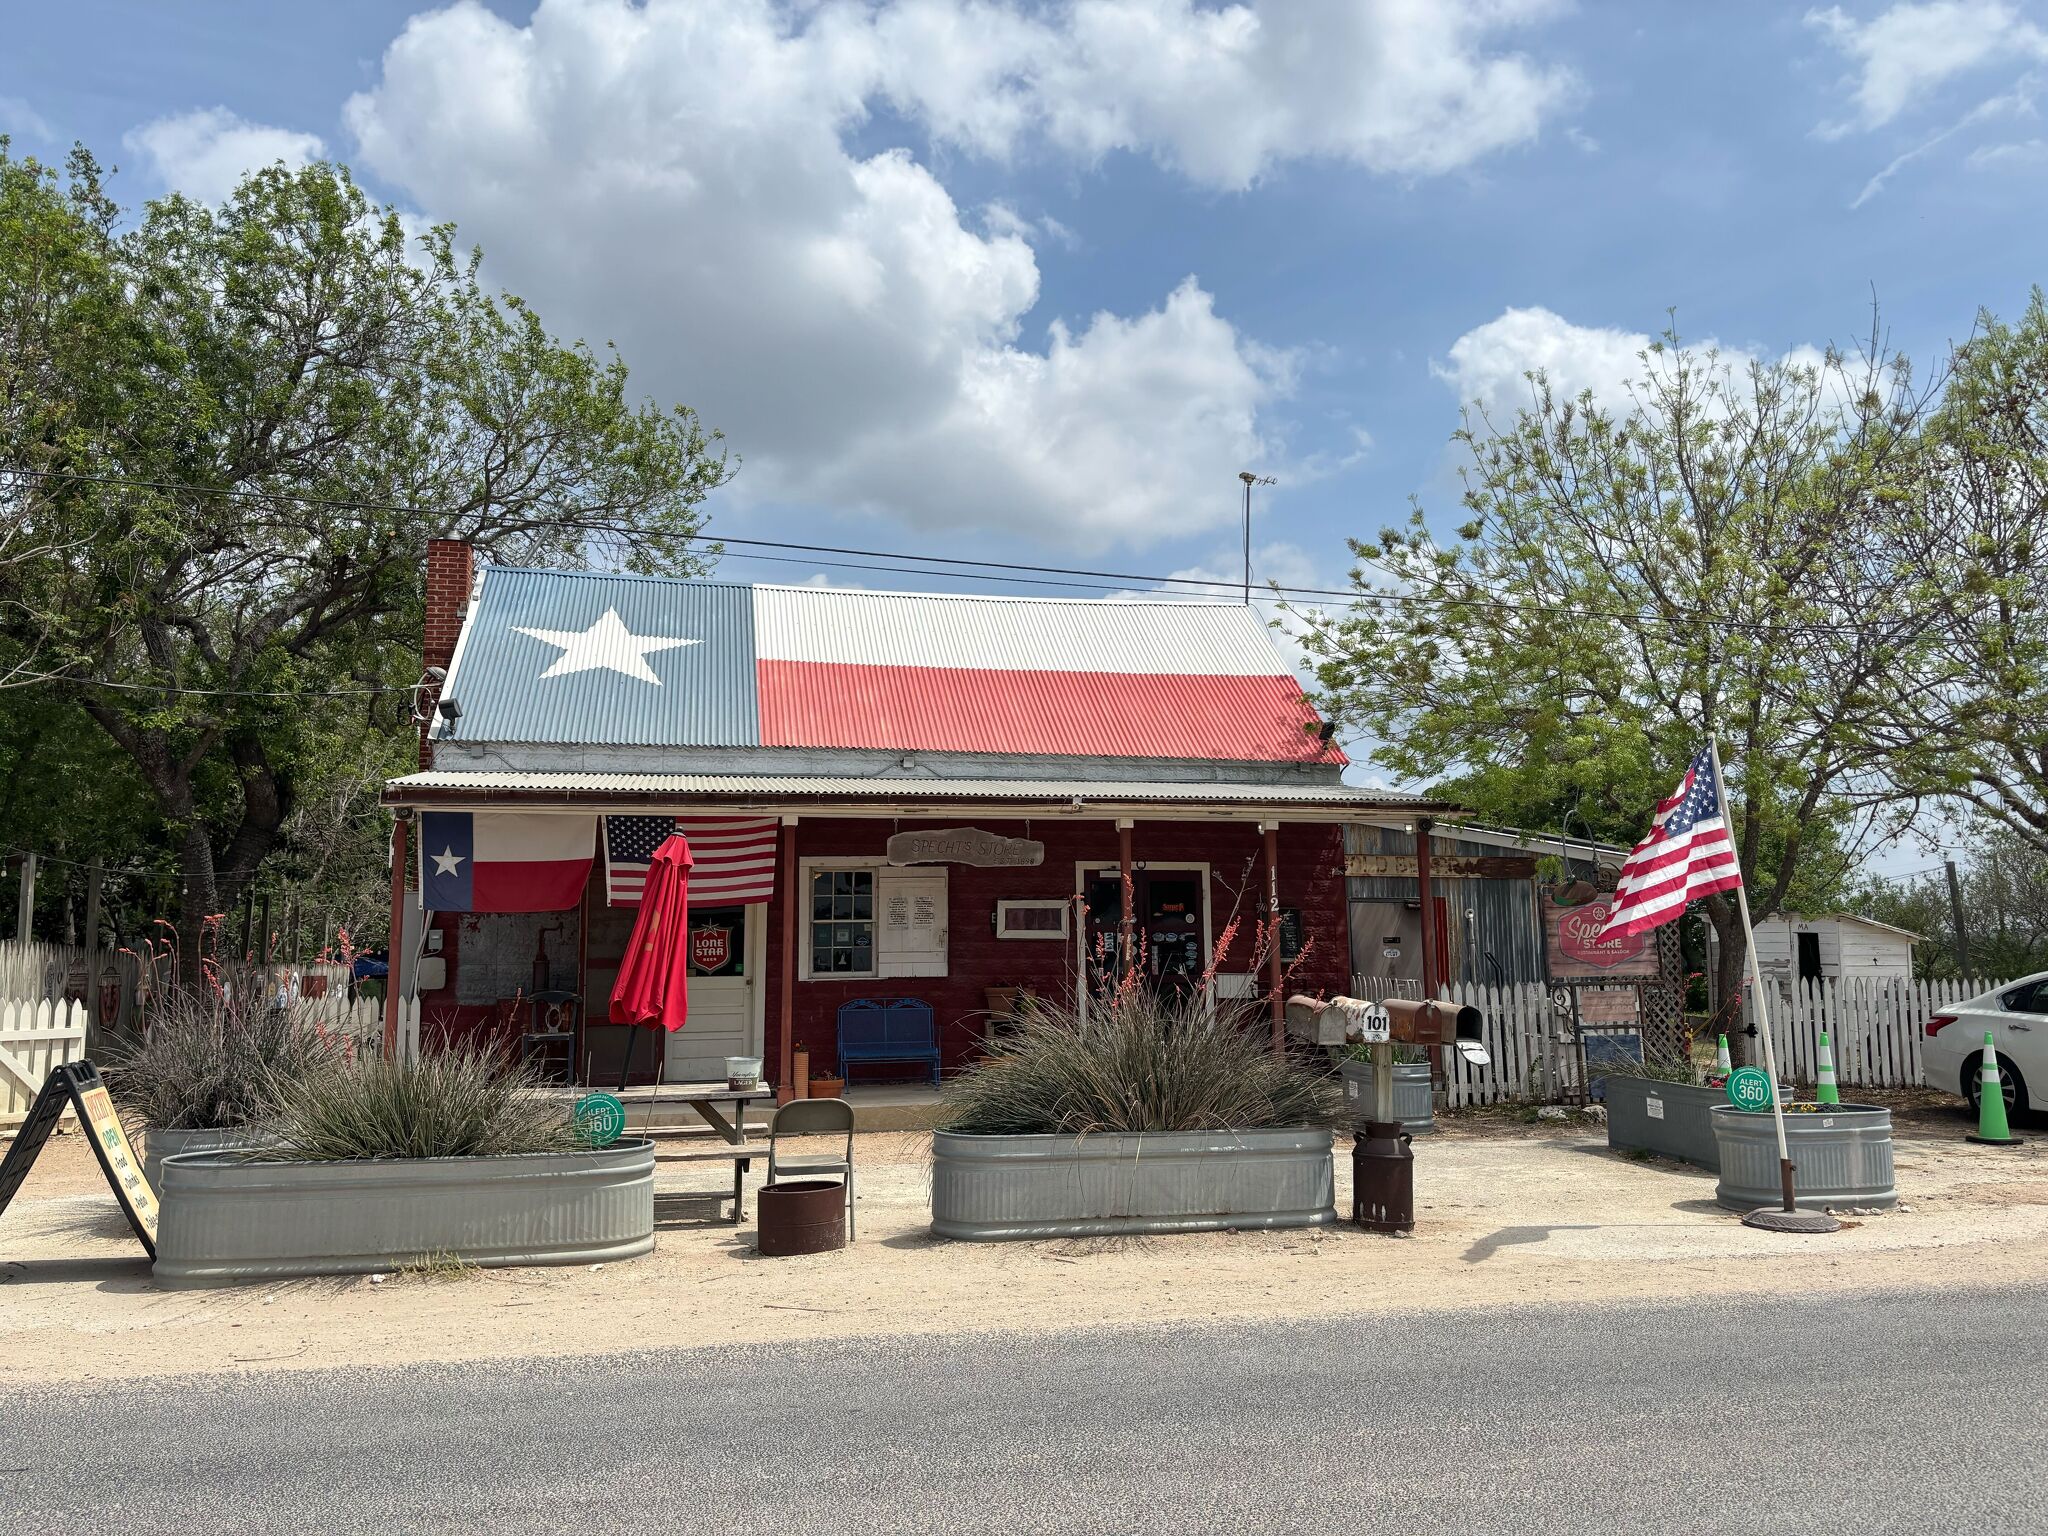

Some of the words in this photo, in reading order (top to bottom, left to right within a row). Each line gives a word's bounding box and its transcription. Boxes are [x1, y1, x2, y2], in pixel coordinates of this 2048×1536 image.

[911, 838, 972, 853] SPECHT'S
[977, 841, 1023, 857] STORE
[696, 939, 724, 948] LONE
[696, 947, 724, 957] STAR
[1367, 1015, 1387, 1032] 101
[1740, 1078, 1763, 1087] ALERT
[1738, 1085, 1763, 1101] 360
[102, 1127, 121, 1150] OPEN
[115, 1153, 128, 1170] Food
[125, 1173, 140, 1191] Drinks
